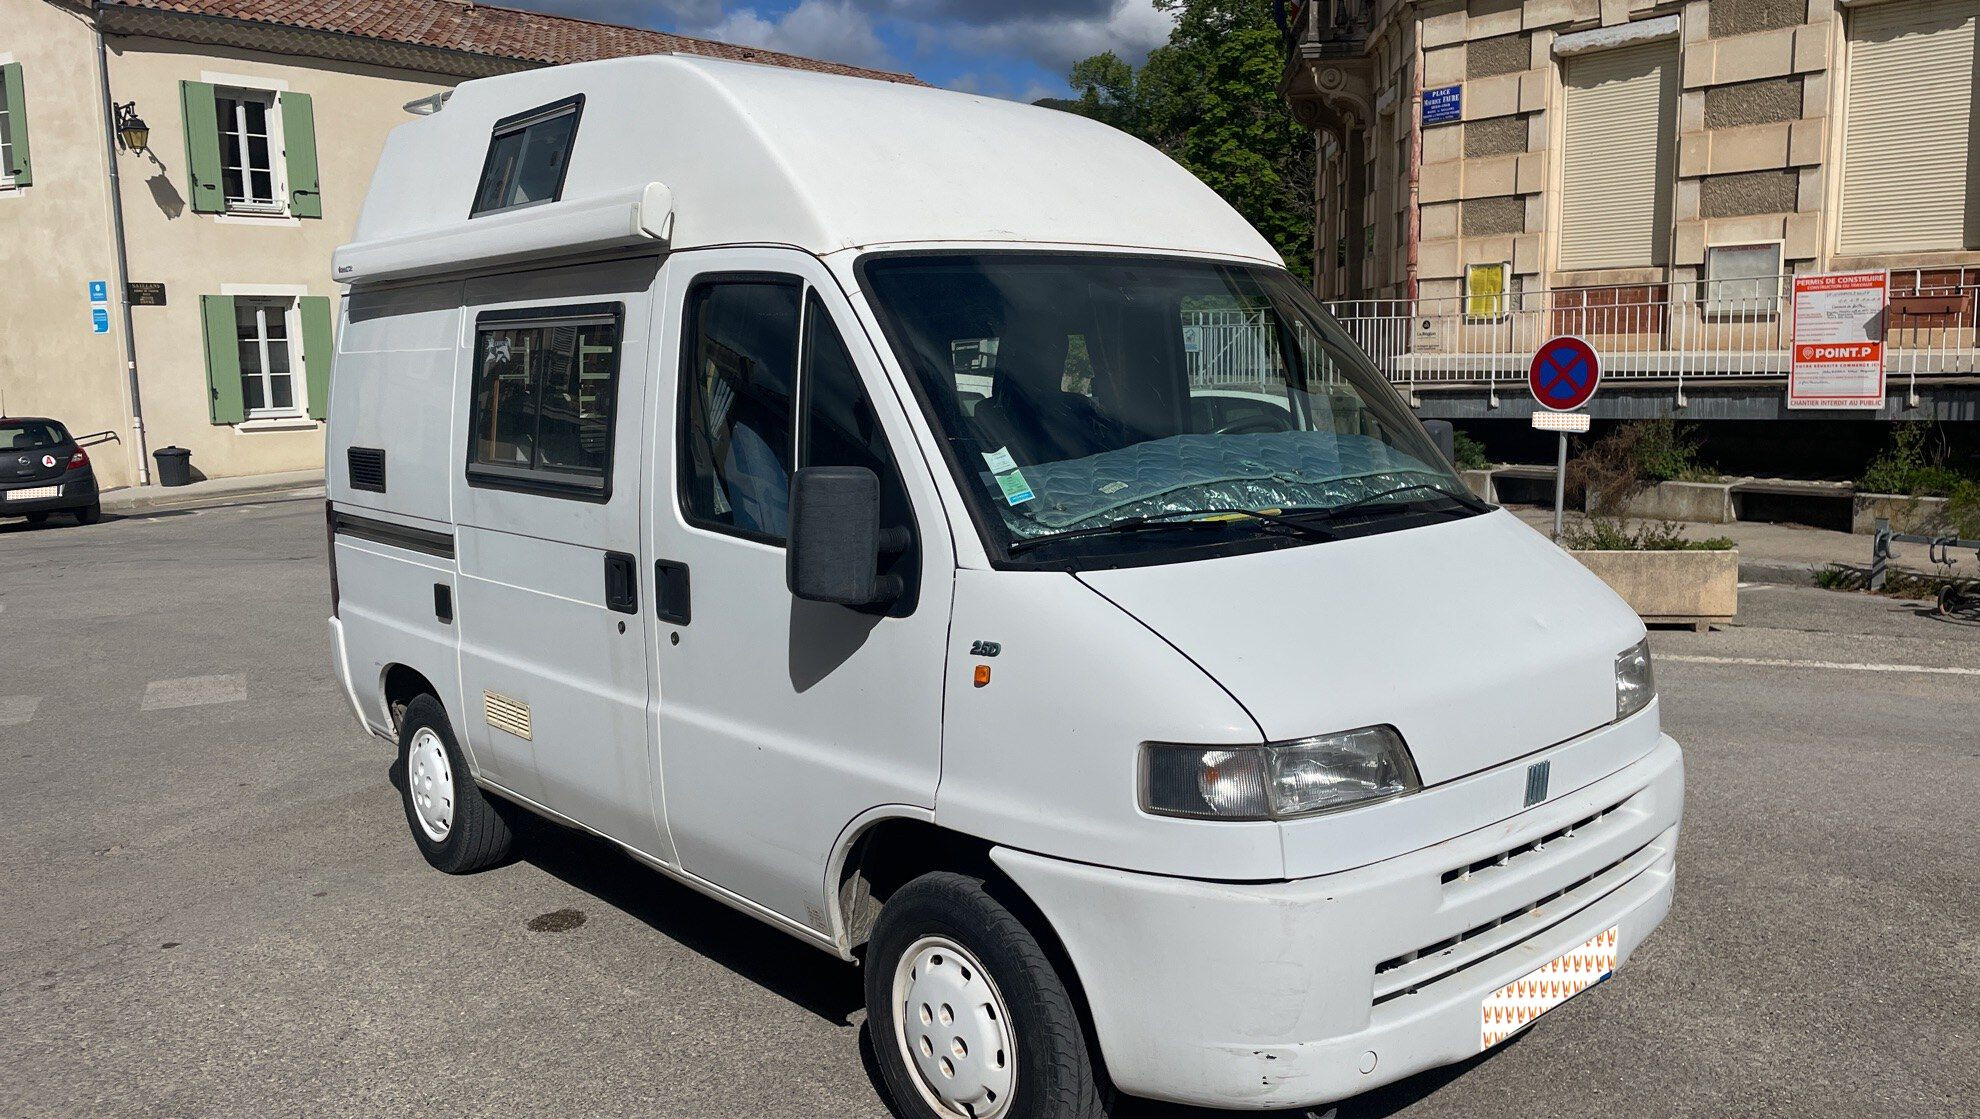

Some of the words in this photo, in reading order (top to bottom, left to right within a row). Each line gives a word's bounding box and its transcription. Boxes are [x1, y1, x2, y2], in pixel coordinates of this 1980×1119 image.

[1432, 89, 1451, 97] PLACE
[1442, 94, 1459, 103] FAURE
[1796, 278, 1824, 286] PERMIS
[1837, 275, 1884, 284] CONSTRUIRE
[1815, 347, 1872, 359] POINT.P
[46, 456, 53, 465] A
